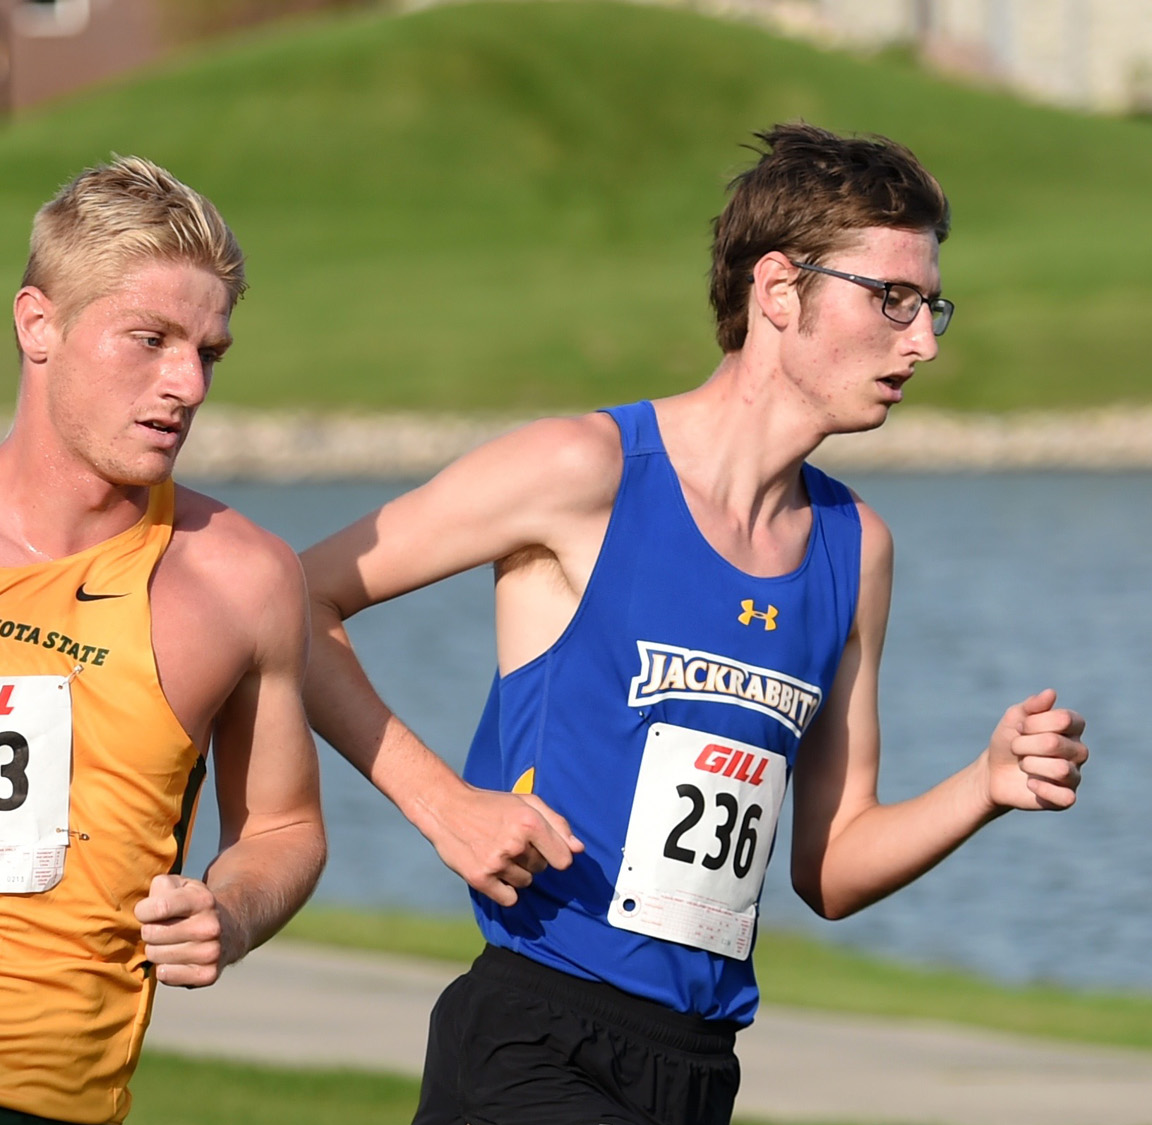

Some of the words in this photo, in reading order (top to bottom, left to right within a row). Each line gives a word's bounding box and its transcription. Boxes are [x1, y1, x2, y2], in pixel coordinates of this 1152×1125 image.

[42, 631, 109, 666] STATE
[694, 743, 768, 786] GILL
[663, 784, 762, 879] 236
